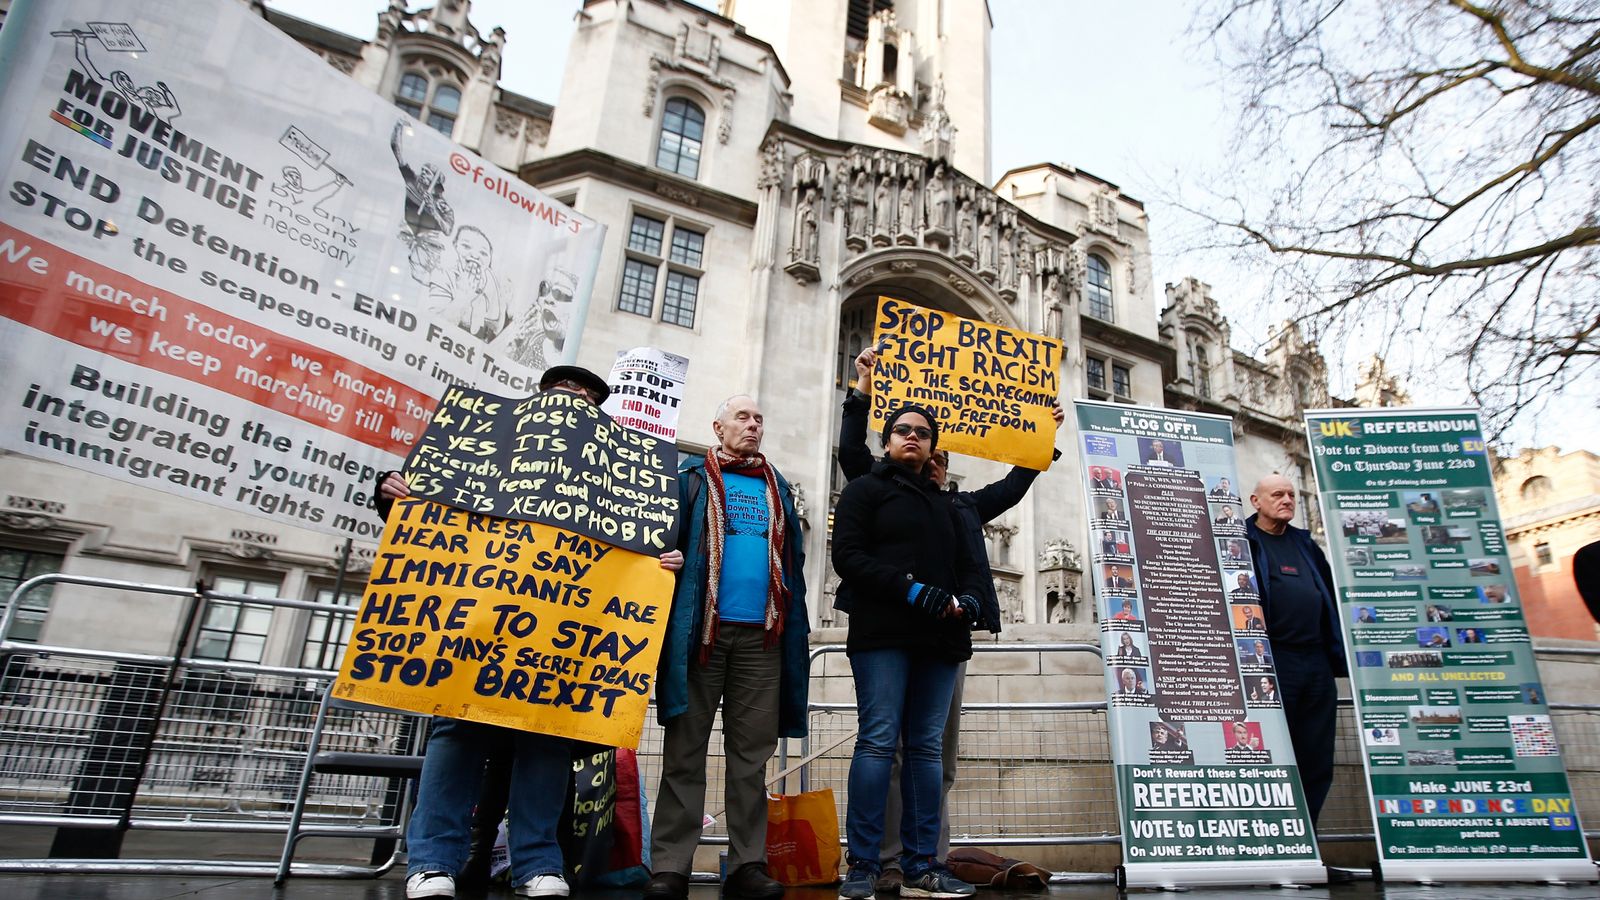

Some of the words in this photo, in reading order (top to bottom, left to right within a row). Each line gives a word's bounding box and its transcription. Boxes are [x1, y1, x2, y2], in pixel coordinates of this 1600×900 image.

[63, 69, 264, 193] MOVEMENT
[55, 98, 113, 140] FOR
[117, 135, 257, 219] JUSTICE
[272, 182, 304, 206] by
[312, 206, 361, 234] any
[450, 152, 583, 235] @followMFJ
[263, 212, 357, 268] necessary
[268, 199, 358, 248] means
[9, 180, 120, 240] STOP
[133, 236, 188, 276] the
[200, 269, 398, 361] scapegoating
[404, 353, 428, 372] of
[20, 139, 120, 204] END
[136, 196, 320, 294] Detention
[353, 292, 417, 333] END
[426, 323, 477, 365] Fast
[482, 353, 541, 395] Track
[65, 270, 167, 322] march
[290, 352, 323, 377] we
[333, 370, 397, 409] march
[879, 300, 945, 341] STOP
[958, 320, 1058, 368] BREXIT
[89, 316, 132, 345] we
[149, 331, 222, 376] keep
[235, 364, 346, 423] marching
[355, 407, 384, 434] till
[390, 427, 414, 446] we
[619, 371, 674, 390] STOP
[877, 333, 960, 371] FIGHT
[973, 351, 1057, 391] RACISM
[70, 363, 230, 437] Building
[240, 421, 293, 454] the
[443, 387, 503, 416] Hate
[512, 391, 600, 420] crimes
[610, 419, 659, 450] rise
[609, 384, 681, 408] BREXIT
[621, 399, 643, 412] END
[644, 404, 661, 418] the
[906, 386, 1022, 417] immigrants
[959, 408, 1036, 433] FREEDOM
[22, 383, 239, 473] integrated,
[249, 457, 335, 498] youth
[516, 410, 579, 435] post
[593, 425, 664, 470] Brexit
[1102, 425, 1122, 433] Auction
[1120, 416, 1160, 431] FLOG
[1163, 421, 1198, 435] OFF!
[1314, 444, 1342, 456] Vote
[1344, 444, 1361, 456] for
[1363, 443, 1409, 455] Divorce
[1411, 442, 1440, 455] from
[1441, 442, 1459, 453] the
[1462, 440, 1484, 452] EU
[1320, 420, 1353, 437] UK
[1363, 419, 1477, 434] REFERENDUM
[24, 421, 227, 497] immigrant
[236, 487, 325, 524] rights
[419, 445, 502, 478] Friends,
[511, 455, 580, 484] family,
[582, 467, 680, 511] colleagues
[448, 434, 498, 456] YES
[581, 442, 676, 493] RACIST
[1331, 461, 1352, 472] On
[1354, 459, 1411, 473] Thursday
[1413, 458, 1444, 472] June
[1447, 458, 1476, 469] 23rd
[405, 471, 445, 497] YES
[453, 488, 496, 512] ITS
[410, 454, 456, 480] live
[465, 476, 487, 494] in
[498, 475, 547, 493] fear
[555, 481, 589, 503] and
[596, 495, 675, 532] uncertainty
[727, 504, 750, 512] Down
[751, 506, 766, 515] The
[390, 524, 469, 554] HEAR
[484, 539, 521, 563] US
[532, 550, 592, 582] SAY
[397, 499, 536, 544] THERESA
[553, 531, 614, 562] MAY
[370, 552, 593, 609] IMMIGRANTS
[602, 596, 658, 625] ARE
[1345, 590, 1386, 598] Unreasonable
[1386, 590, 1417, 598] Behaviour
[360, 592, 478, 632] HERE
[492, 604, 538, 639] TO
[552, 620, 650, 666] STAY
[349, 653, 453, 689] STOP
[473, 664, 627, 718] BREXIT
[355, 628, 427, 653] STOP
[515, 647, 585, 679] SECRET
[590, 664, 651, 697] DEALS
[1391, 673, 1414, 682] AND
[1418, 672, 1439, 681] ALL
[1441, 672, 1505, 681] UNELECTED
[1133, 767, 1162, 778] Don't
[1165, 768, 1204, 778] Reward
[1207, 768, 1236, 778] these
[1239, 768, 1287, 778] Sell-outs
[1133, 782, 1294, 808] REFERENDUM
[1409, 781, 1447, 794] Make
[1450, 781, 1493, 793] JUNE
[1496, 780, 1532, 793] 23rd
[1130, 820, 1175, 839] VOTE
[1176, 820, 1195, 838] to
[1198, 819, 1250, 839] LEAVE
[1251, 818, 1279, 837] the
[1281, 818, 1306, 837] EU
[1378, 798, 1527, 814] INDEPENDENCE
[1531, 798, 1571, 813] DAY
[1391, 818, 1415, 828] From
[1416, 818, 1494, 828] UNDEMOCRATIC
[1495, 818, 1504, 827] &
[1505, 817, 1550, 827] ABUSIVE
[1553, 817, 1571, 827] EU
[1130, 846, 1146, 857] On
[1149, 845, 1183, 857] JUNE
[1187, 845, 1214, 856] 23rd
[1216, 844, 1236, 856] the
[1238, 844, 1274, 857] People
[1277, 843, 1313, 855] Decide
[1460, 829, 1500, 840] partners
